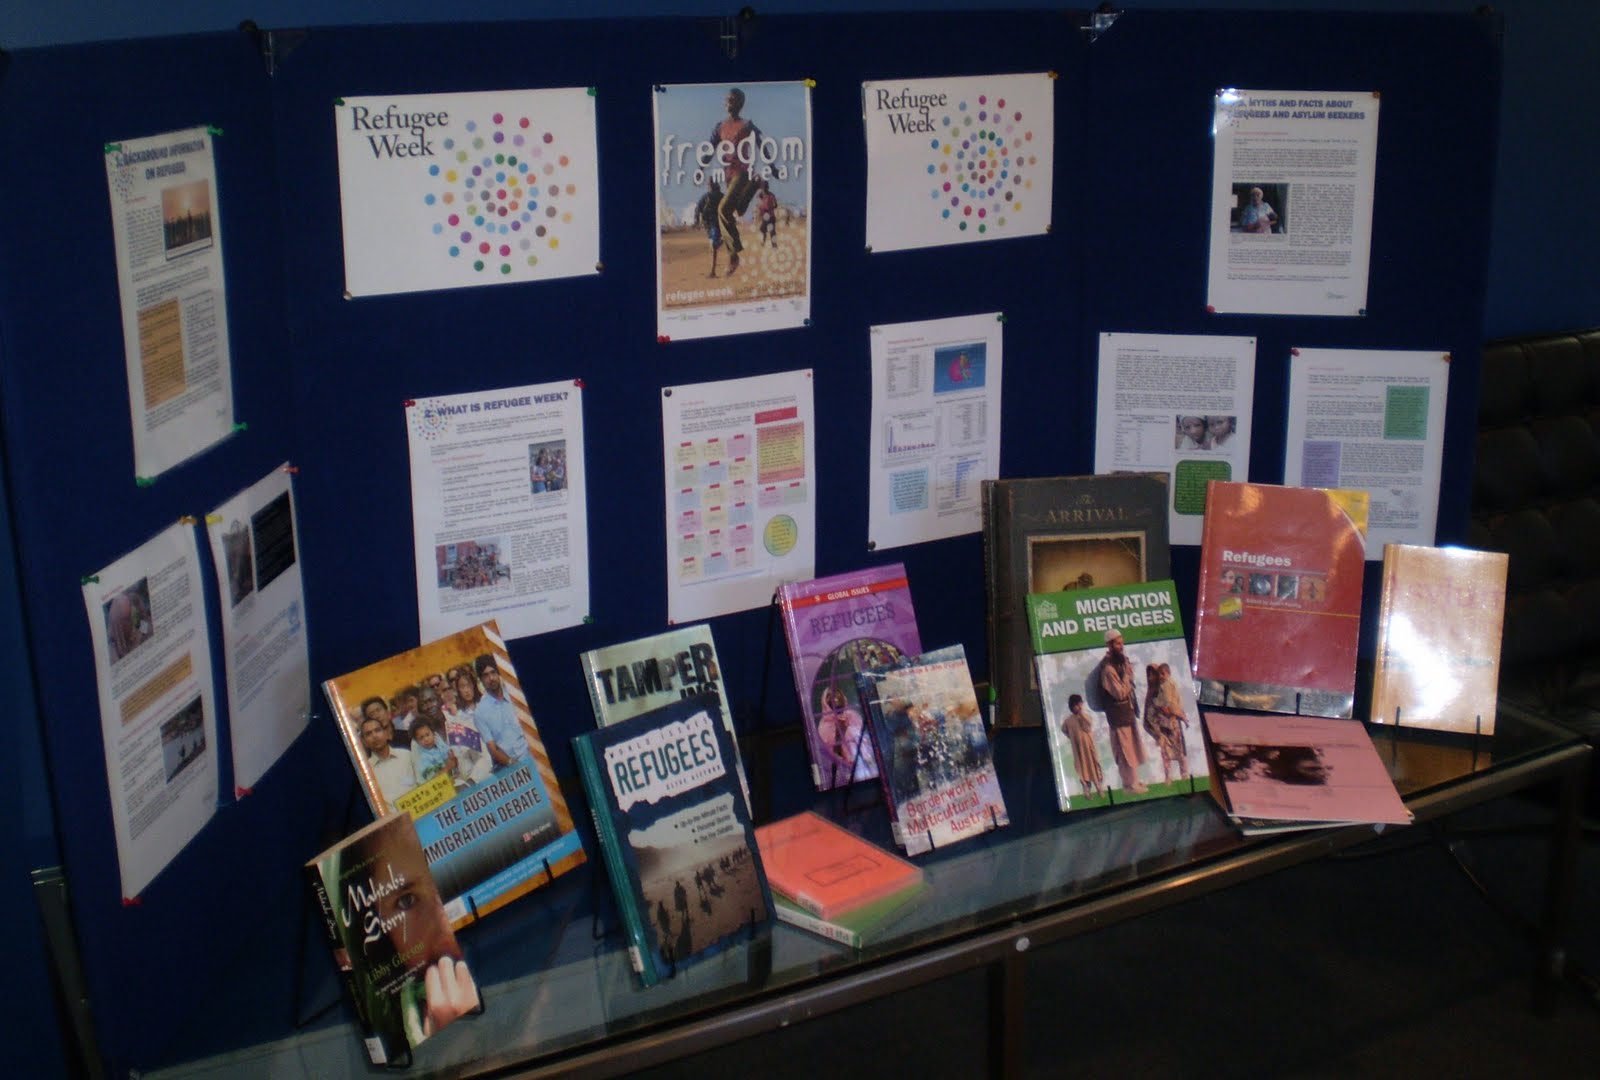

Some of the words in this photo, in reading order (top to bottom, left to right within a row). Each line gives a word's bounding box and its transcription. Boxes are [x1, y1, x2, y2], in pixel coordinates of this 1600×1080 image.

[875, 88, 948, 115] Refugee
[1272, 110, 1290, 119] AND
[1292, 111, 1326, 120] ASYLUM
[1327, 112, 1366, 121] SEEKERS
[1279, 99, 1297, 108] AND
[1298, 100, 1324, 108] FACTS
[1325, 100, 1354, 109] ABOUT
[351, 104, 449, 137] Refugee
[887, 112, 937, 134] Week
[367, 133, 435, 159] Week
[662, 131, 804, 169] freedom
[662, 167, 726, 187] from
[746, 163, 804, 182] fear
[665, 289, 705, 302] refugee
[706, 286, 734, 298] week
[436, 404, 468, 417] WHAT
[470, 402, 481, 413] IS
[483, 397, 532, 412] REFUGEE
[533, 391, 569, 406] WEEK?
[1045, 507, 1129, 525] ARRIVAL
[1223, 549, 1292, 568] Refugees
[827, 589, 850, 602] GLOBAL
[850, 585, 870, 597] ISSUES
[1075, 591, 1172, 616] MIGRATION
[808, 602, 896, 637] REFUGEES
[1041, 619, 1079, 639] AND
[1084, 608, 1176, 634] REFUGEES
[595, 643, 719, 706] TAMPER
[609, 738, 651, 759] WORLD
[661, 717, 708, 741] ISSUES
[614, 729, 717, 796] REFUGEES
[399, 789, 431, 811] What's
[431, 777, 449, 793] the
[412, 790, 444, 815] Issue?
[434, 805, 463, 830] THE
[462, 764, 534, 815] AUSTRALIAN
[905, 779, 976, 818] Borderwork
[976, 772, 990, 786] in
[423, 812, 499, 865] MMIGRATION
[498, 786, 543, 822] DEBATE
[906, 790, 980, 836] Multicultural
[363, 908, 408, 957] Story
[366, 962, 392, 987] Libby
[391, 940, 426, 970] Gleeson
